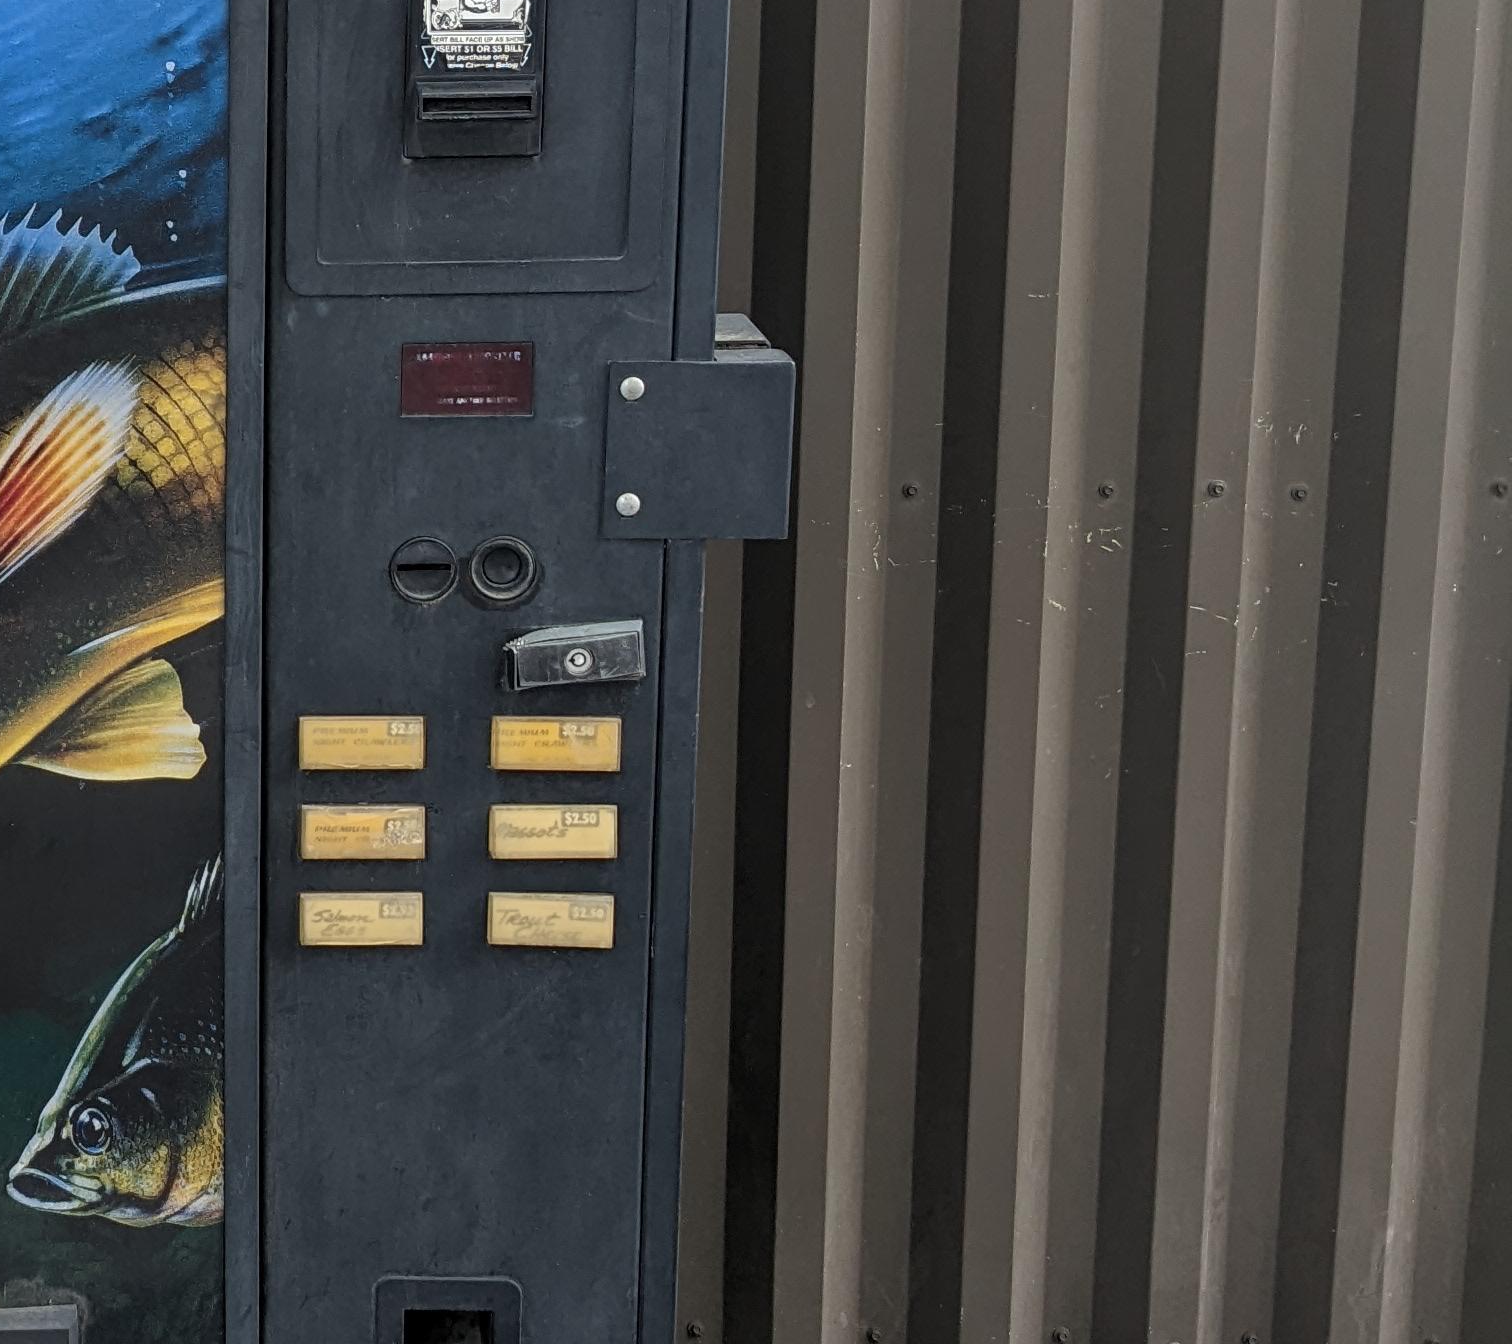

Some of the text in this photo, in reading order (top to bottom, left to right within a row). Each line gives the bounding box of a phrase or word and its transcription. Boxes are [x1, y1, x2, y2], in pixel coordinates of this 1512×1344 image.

[476, 44, 490, 53] OR
[504, 43, 524, 53] BILL
[457, 54, 492, 62] purchase
[564, 811, 597, 826] $2.50
